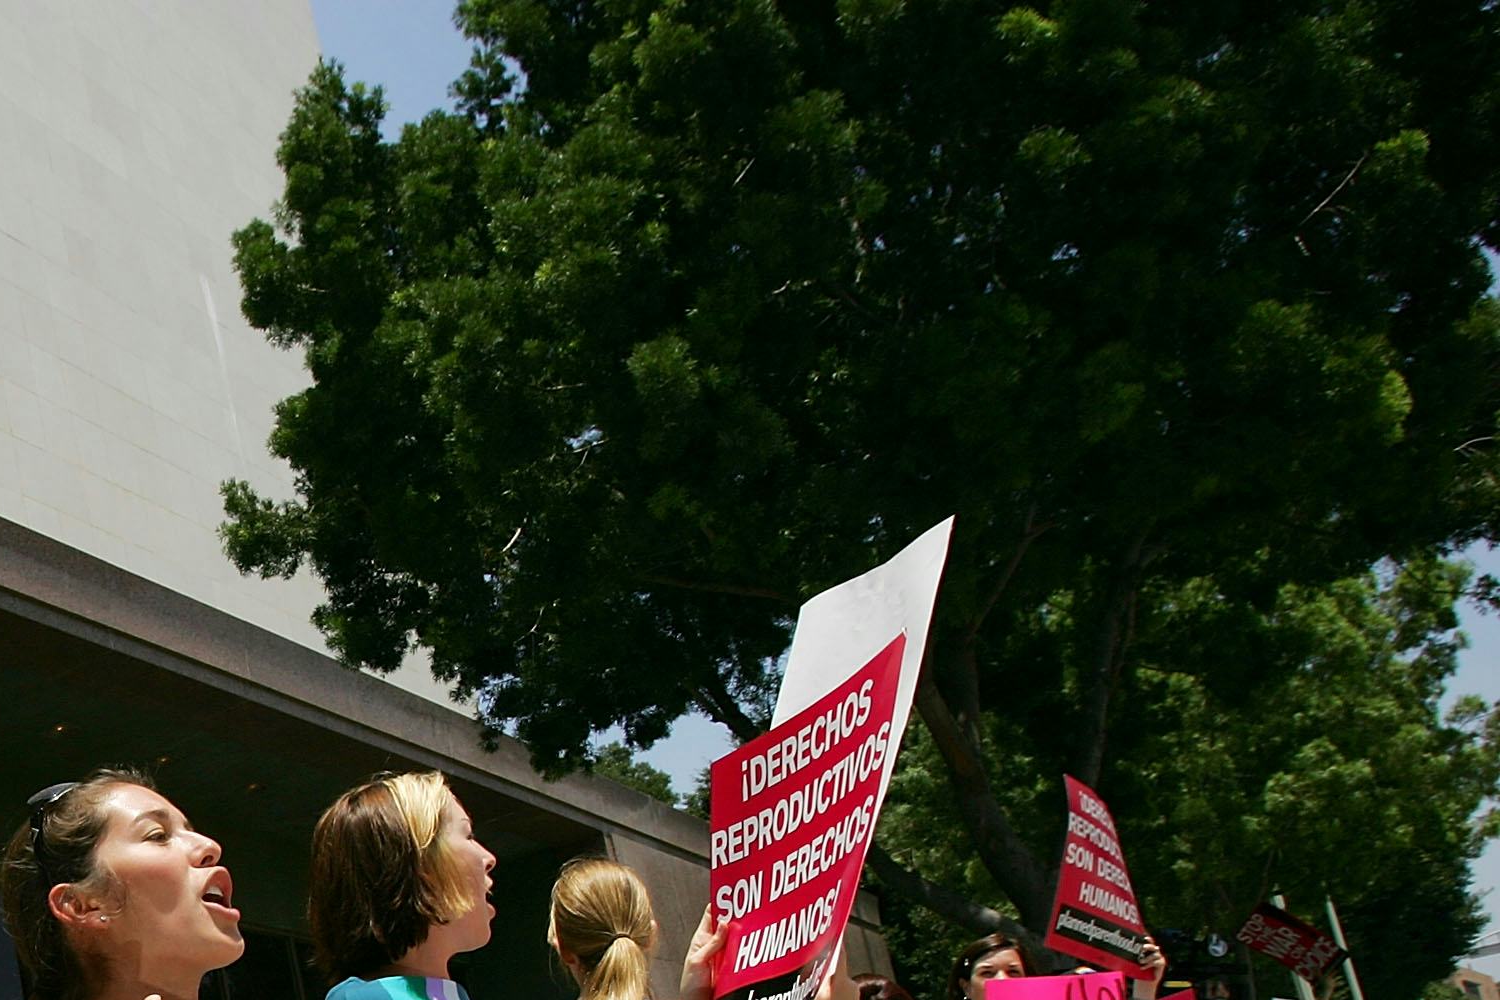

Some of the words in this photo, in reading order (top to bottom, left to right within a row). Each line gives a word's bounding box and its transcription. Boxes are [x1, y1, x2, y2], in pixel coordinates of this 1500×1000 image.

[712, 720, 890, 869] REPRODUCTIVOS
[741, 679, 873, 802] ¡DERECHOS
[716, 870, 764, 925] SON
[770, 794, 874, 902] DERECHOS
[1065, 843, 1094, 872] SON
[734, 879, 842, 973] HUMANOS!
[1236, 913, 1264, 945] STOP
